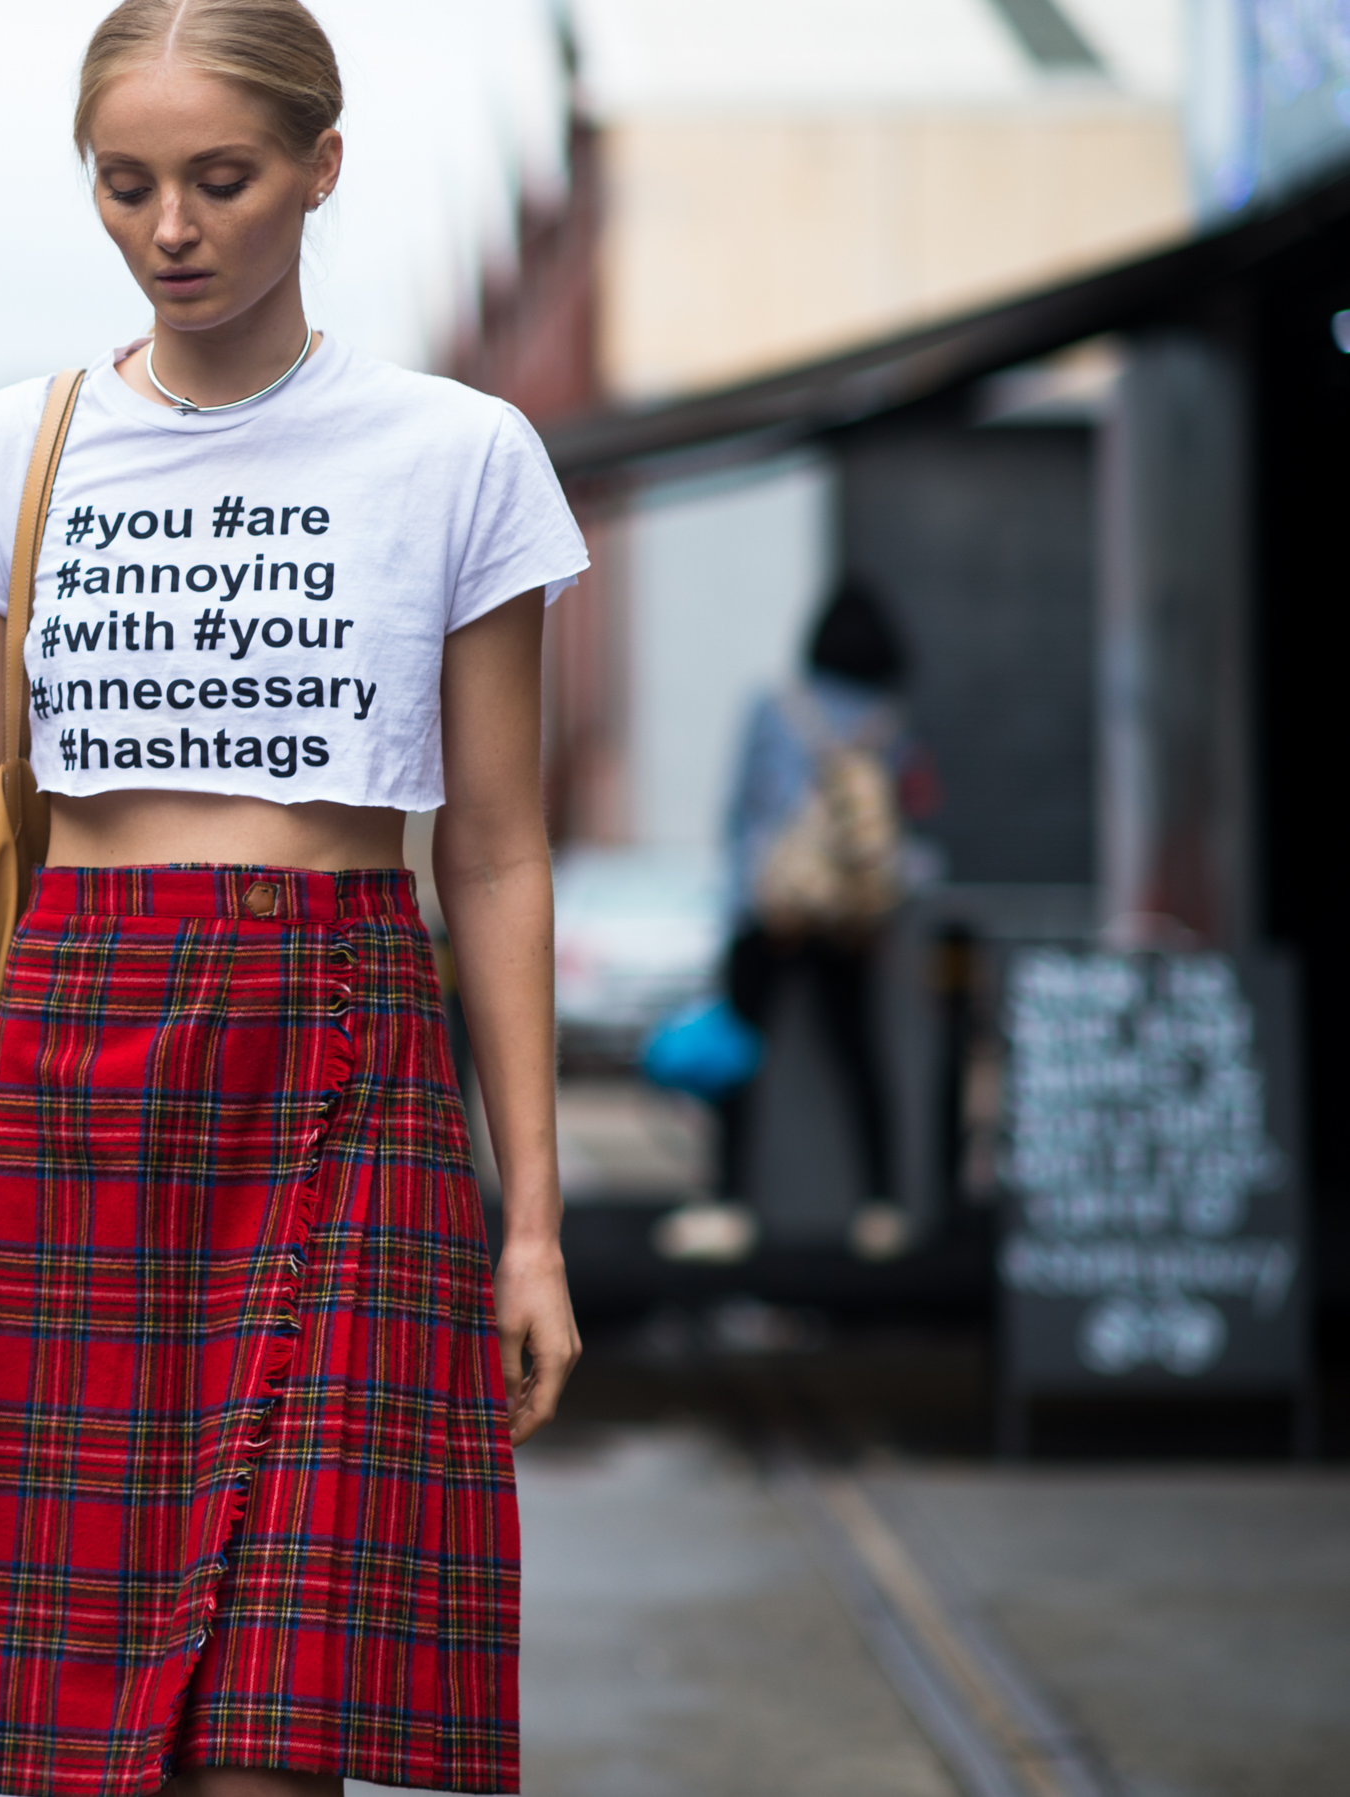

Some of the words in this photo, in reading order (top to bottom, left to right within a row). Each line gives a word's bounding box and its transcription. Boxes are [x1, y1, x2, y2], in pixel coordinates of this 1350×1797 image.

[65, 505, 193, 550] #you
[212, 495, 330, 538] #are
[56, 553, 335, 602] #annoying
[40, 610, 174, 659] #with
[193, 608, 355, 661] #your
[30, 676, 377, 721] #unnecessary
[59, 727, 330, 779] #hashtags
